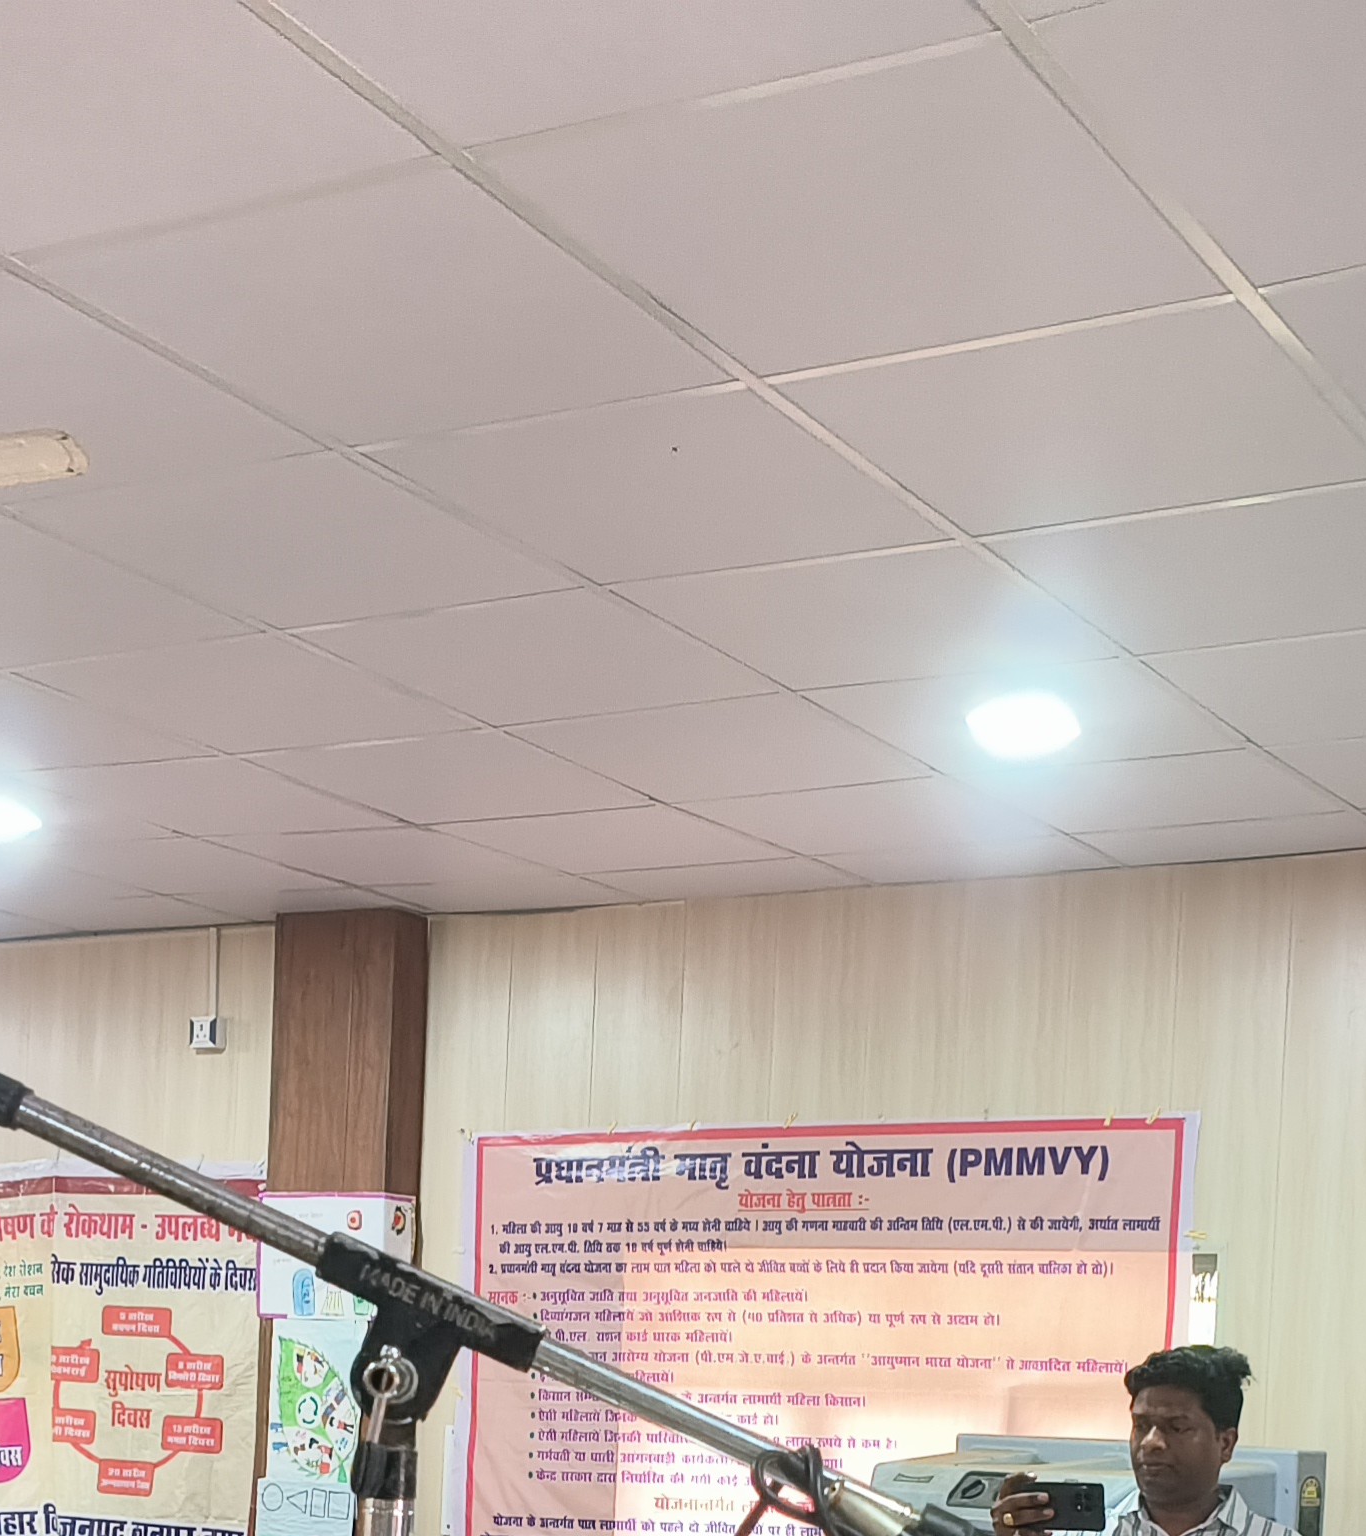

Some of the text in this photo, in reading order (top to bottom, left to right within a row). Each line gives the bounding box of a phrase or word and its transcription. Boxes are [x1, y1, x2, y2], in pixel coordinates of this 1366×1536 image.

[674, 1151, 732, 1190] मातृ
[741, 1143, 821, 1179] वंदना
[830, 1141, 934, 1178] योजना
[947, 1145, 1110, 1184] (PMMVY)
[738, 1189, 807, 1214] योजना हेतु
[64, 1203, 135, 1240] रोकथाम
[155, 1213, 221, 1242] उपलब्ध
[79, 1256, 139, 1295] सामुदायिक
[142, 1256, 208, 1290] गतिविधियों
[210, 1258, 222, 1291] के
[105, 1364, 163, 1397] सुपोषण
[111, 1401, 153, 1429] दिवस
